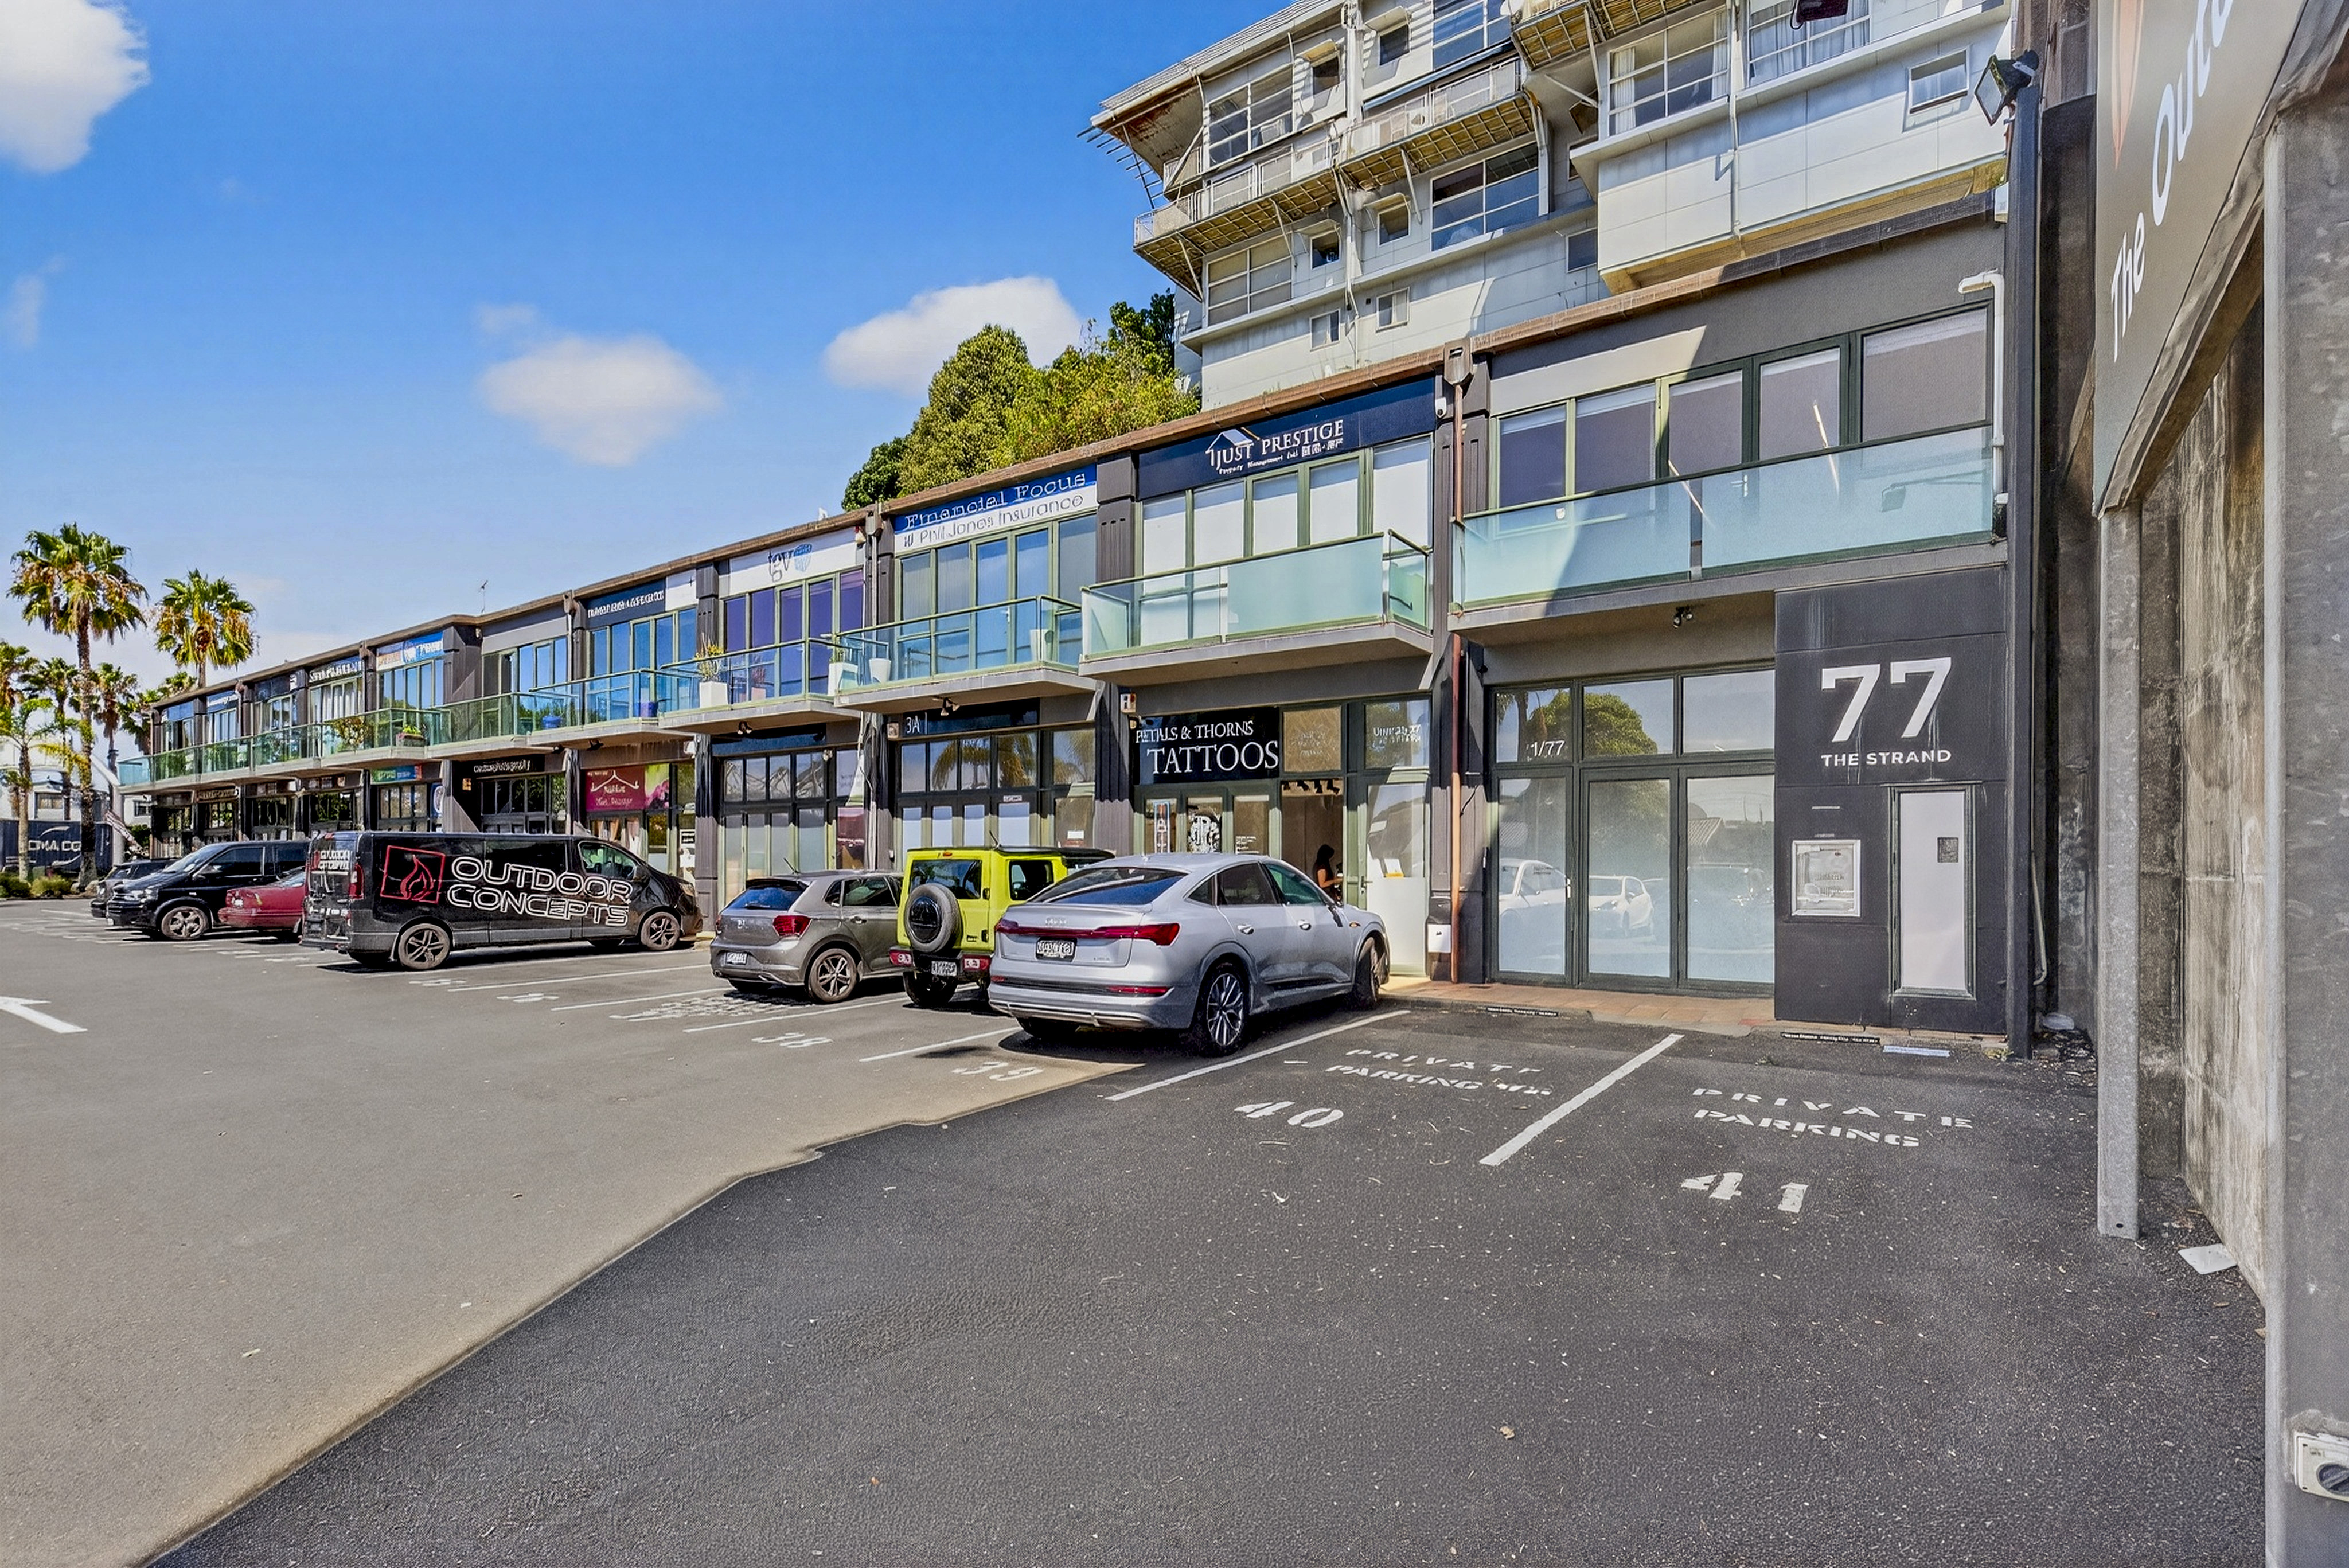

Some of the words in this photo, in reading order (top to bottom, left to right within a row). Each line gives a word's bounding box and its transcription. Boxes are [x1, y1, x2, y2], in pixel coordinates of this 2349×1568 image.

[2111, 212, 2145, 362] The
[1215, 443, 1254, 471] JUST
[1261, 419, 1344, 455] PRESTIGE
[904, 491, 1008, 530] Financial
[1014, 473, 1086, 501] Focus
[947, 515, 994, 538] Jones
[998, 494, 1083, 526] Insurance
[1821, 657, 1952, 743] 77
[906, 715, 920, 734] 3A
[1181, 726, 1192, 740] &
[1194, 720, 1254, 739] THORNS
[1146, 740, 1279, 774] TATTOOS
[1530, 740, 1565, 757] 1/77
[1820, 753, 1859, 767] THE
[1866, 749, 1952, 765] STRAND
[451, 856, 633, 903] OUTDOOR
[447, 883, 629, 926] CONCEPTS
[1325, 1065, 1484, 1090] PARKING
[1345, 1049, 1545, 1074] PRIVATE
[1234, 1101, 1344, 1128] 40
[1692, 1087, 1973, 1129] PRIVATE
[1694, 1109, 1920, 1147] PARKING
[1680, 1171, 1809, 1214] 41
